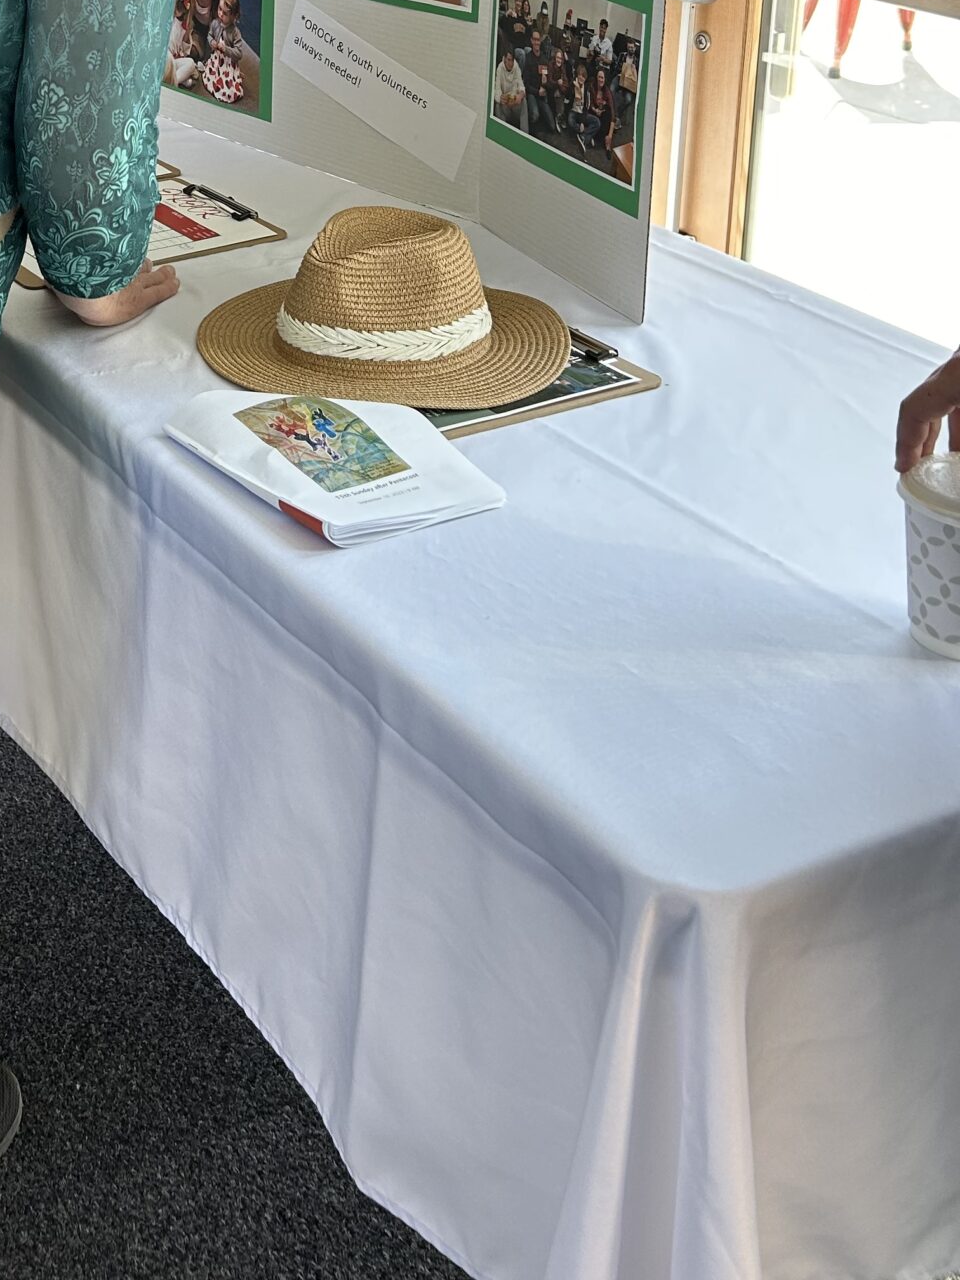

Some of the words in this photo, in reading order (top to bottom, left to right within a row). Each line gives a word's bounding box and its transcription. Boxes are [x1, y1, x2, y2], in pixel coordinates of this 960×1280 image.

[294, 36, 323, 61] always
[324, 57, 362, 88] needed!
[336, 41, 344, 53] &
[347, 47, 373, 73] Youth
[376, 66, 428, 109] Volunteers
